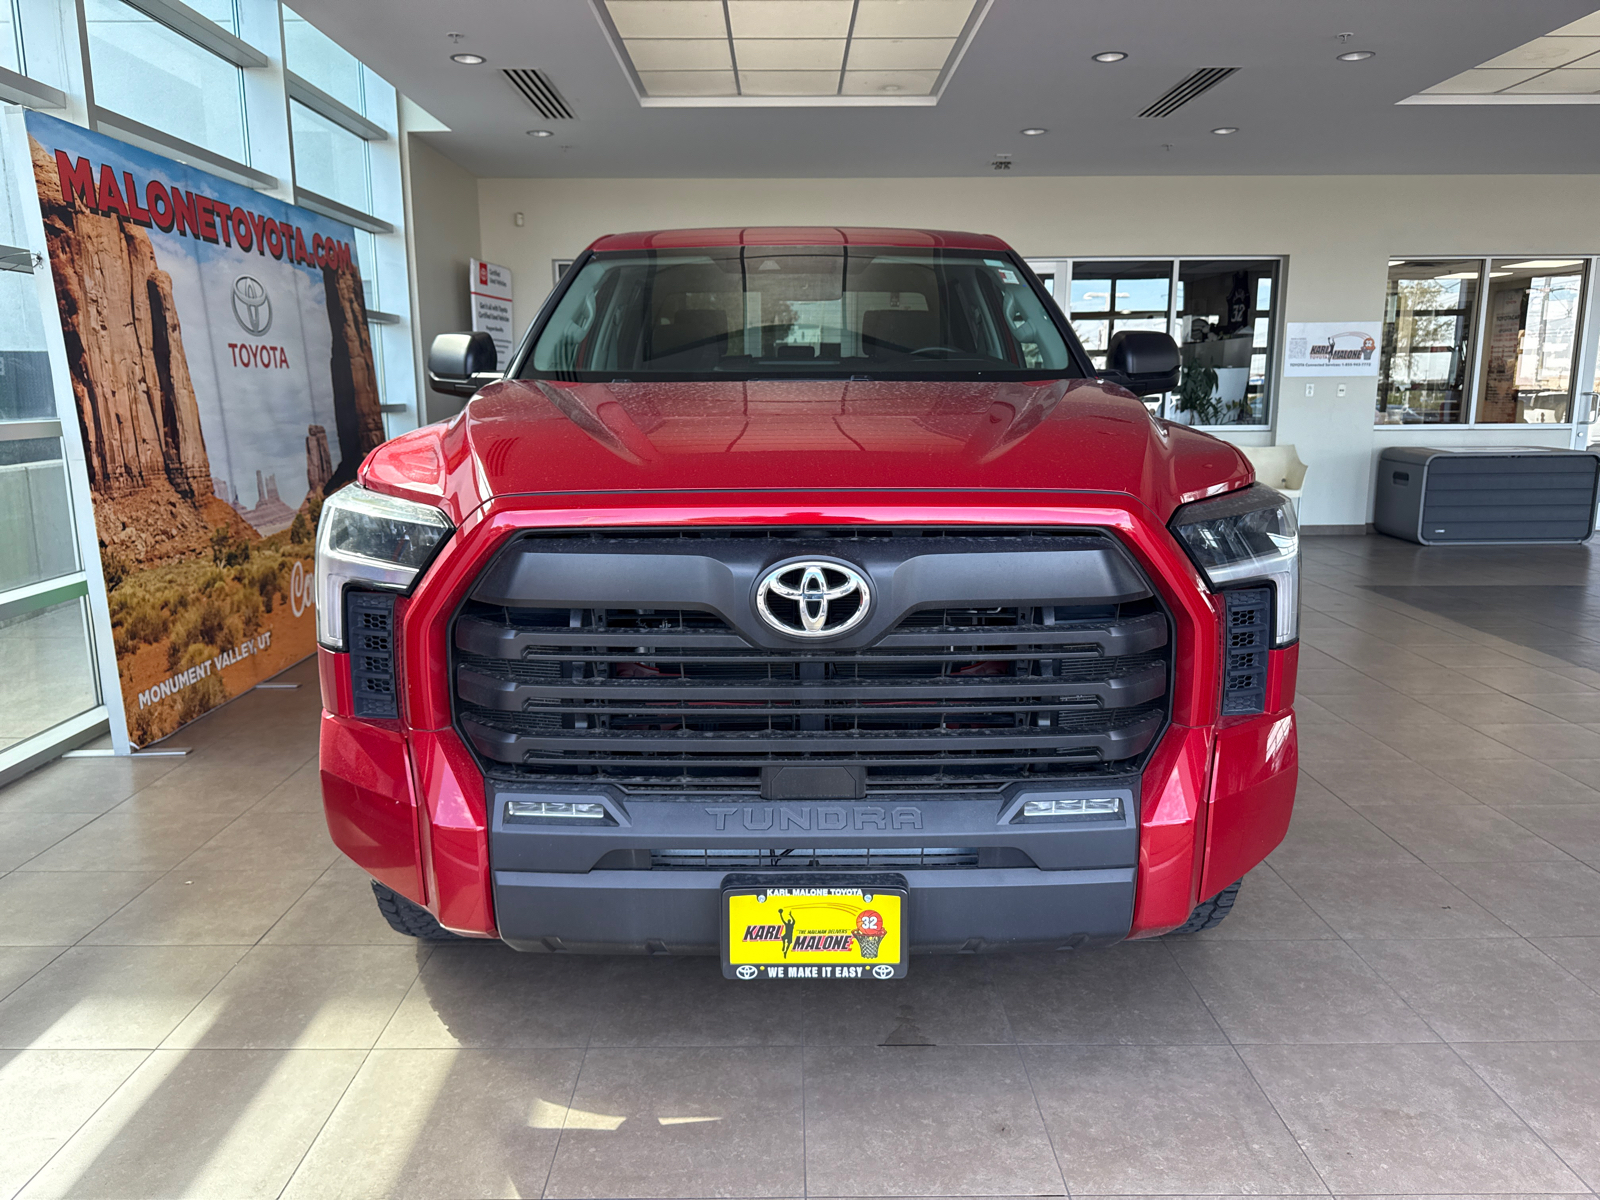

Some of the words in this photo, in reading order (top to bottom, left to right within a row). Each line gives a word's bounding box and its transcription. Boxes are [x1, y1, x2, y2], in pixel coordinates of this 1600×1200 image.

[54, 149, 354, 275] MALONETOYOTA.COM
[1231, 303, 1245, 322] 32
[228, 343, 290, 369] TOYOTA
[1310, 345, 1330, 355] KARL
[1332, 350, 1362, 360] MALONE
[138, 659, 212, 710] MONUMENT
[213, 638, 257, 671] VALLEY,
[257, 631, 271, 650] UT
[704, 806, 924, 831] TUNDRA
[861, 916, 878, 929] 32
[742, 925, 784, 942] KARL
[791, 935, 854, 951] MALONE
[768, 966, 785, 977] WE
[788, 966, 819, 977] MAKE
[822, 966, 832, 977] IT
[836, 966, 863, 977] EASY
